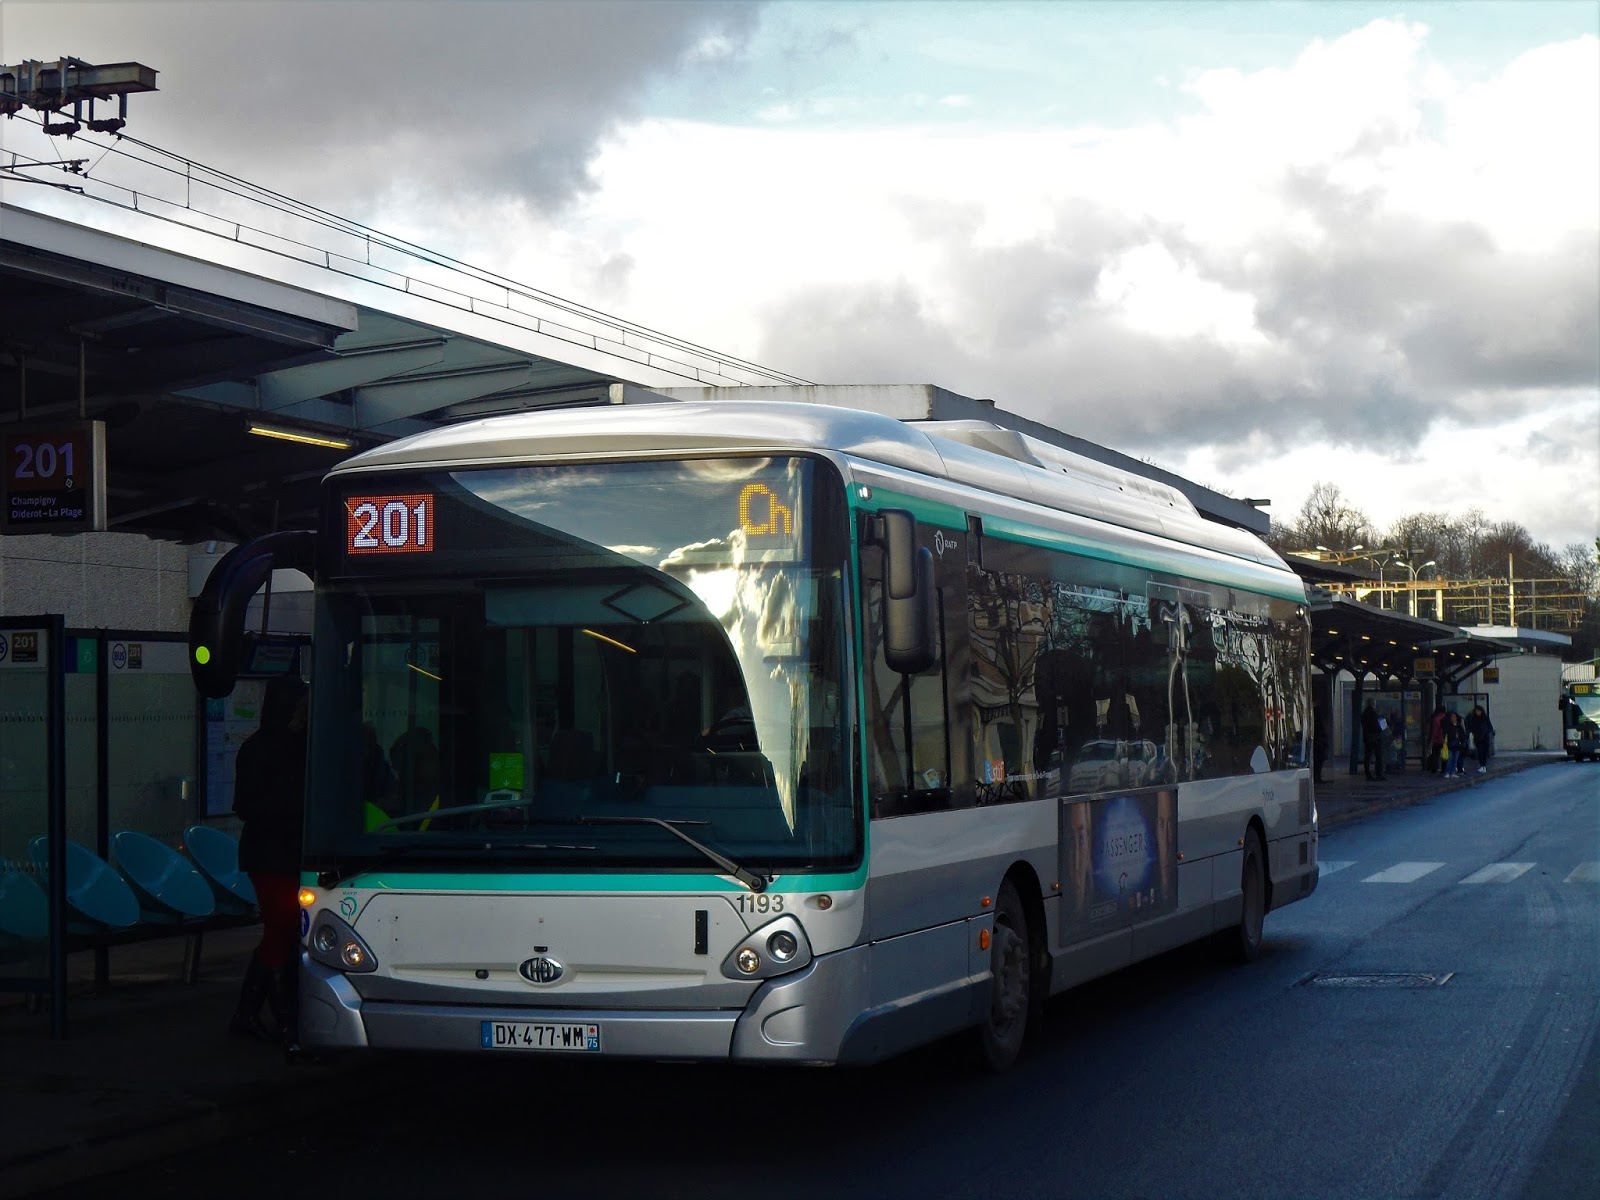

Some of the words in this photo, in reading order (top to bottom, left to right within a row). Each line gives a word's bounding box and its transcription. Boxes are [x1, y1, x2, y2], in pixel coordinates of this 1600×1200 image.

[15, 442, 73, 478] 201
[11, 496, 57, 506] Champigny
[60, 507, 82, 518] Plage
[740, 483, 792, 535] Ch
[354, 500, 427, 548] 201
[945, 539, 958, 549] RATP
[14, 636, 34, 648] 201
[114, 651, 125, 661] BUS
[129, 647, 140, 657] 201
[737, 894, 784, 913] 1193
[588, 1038, 598, 1048] 75
